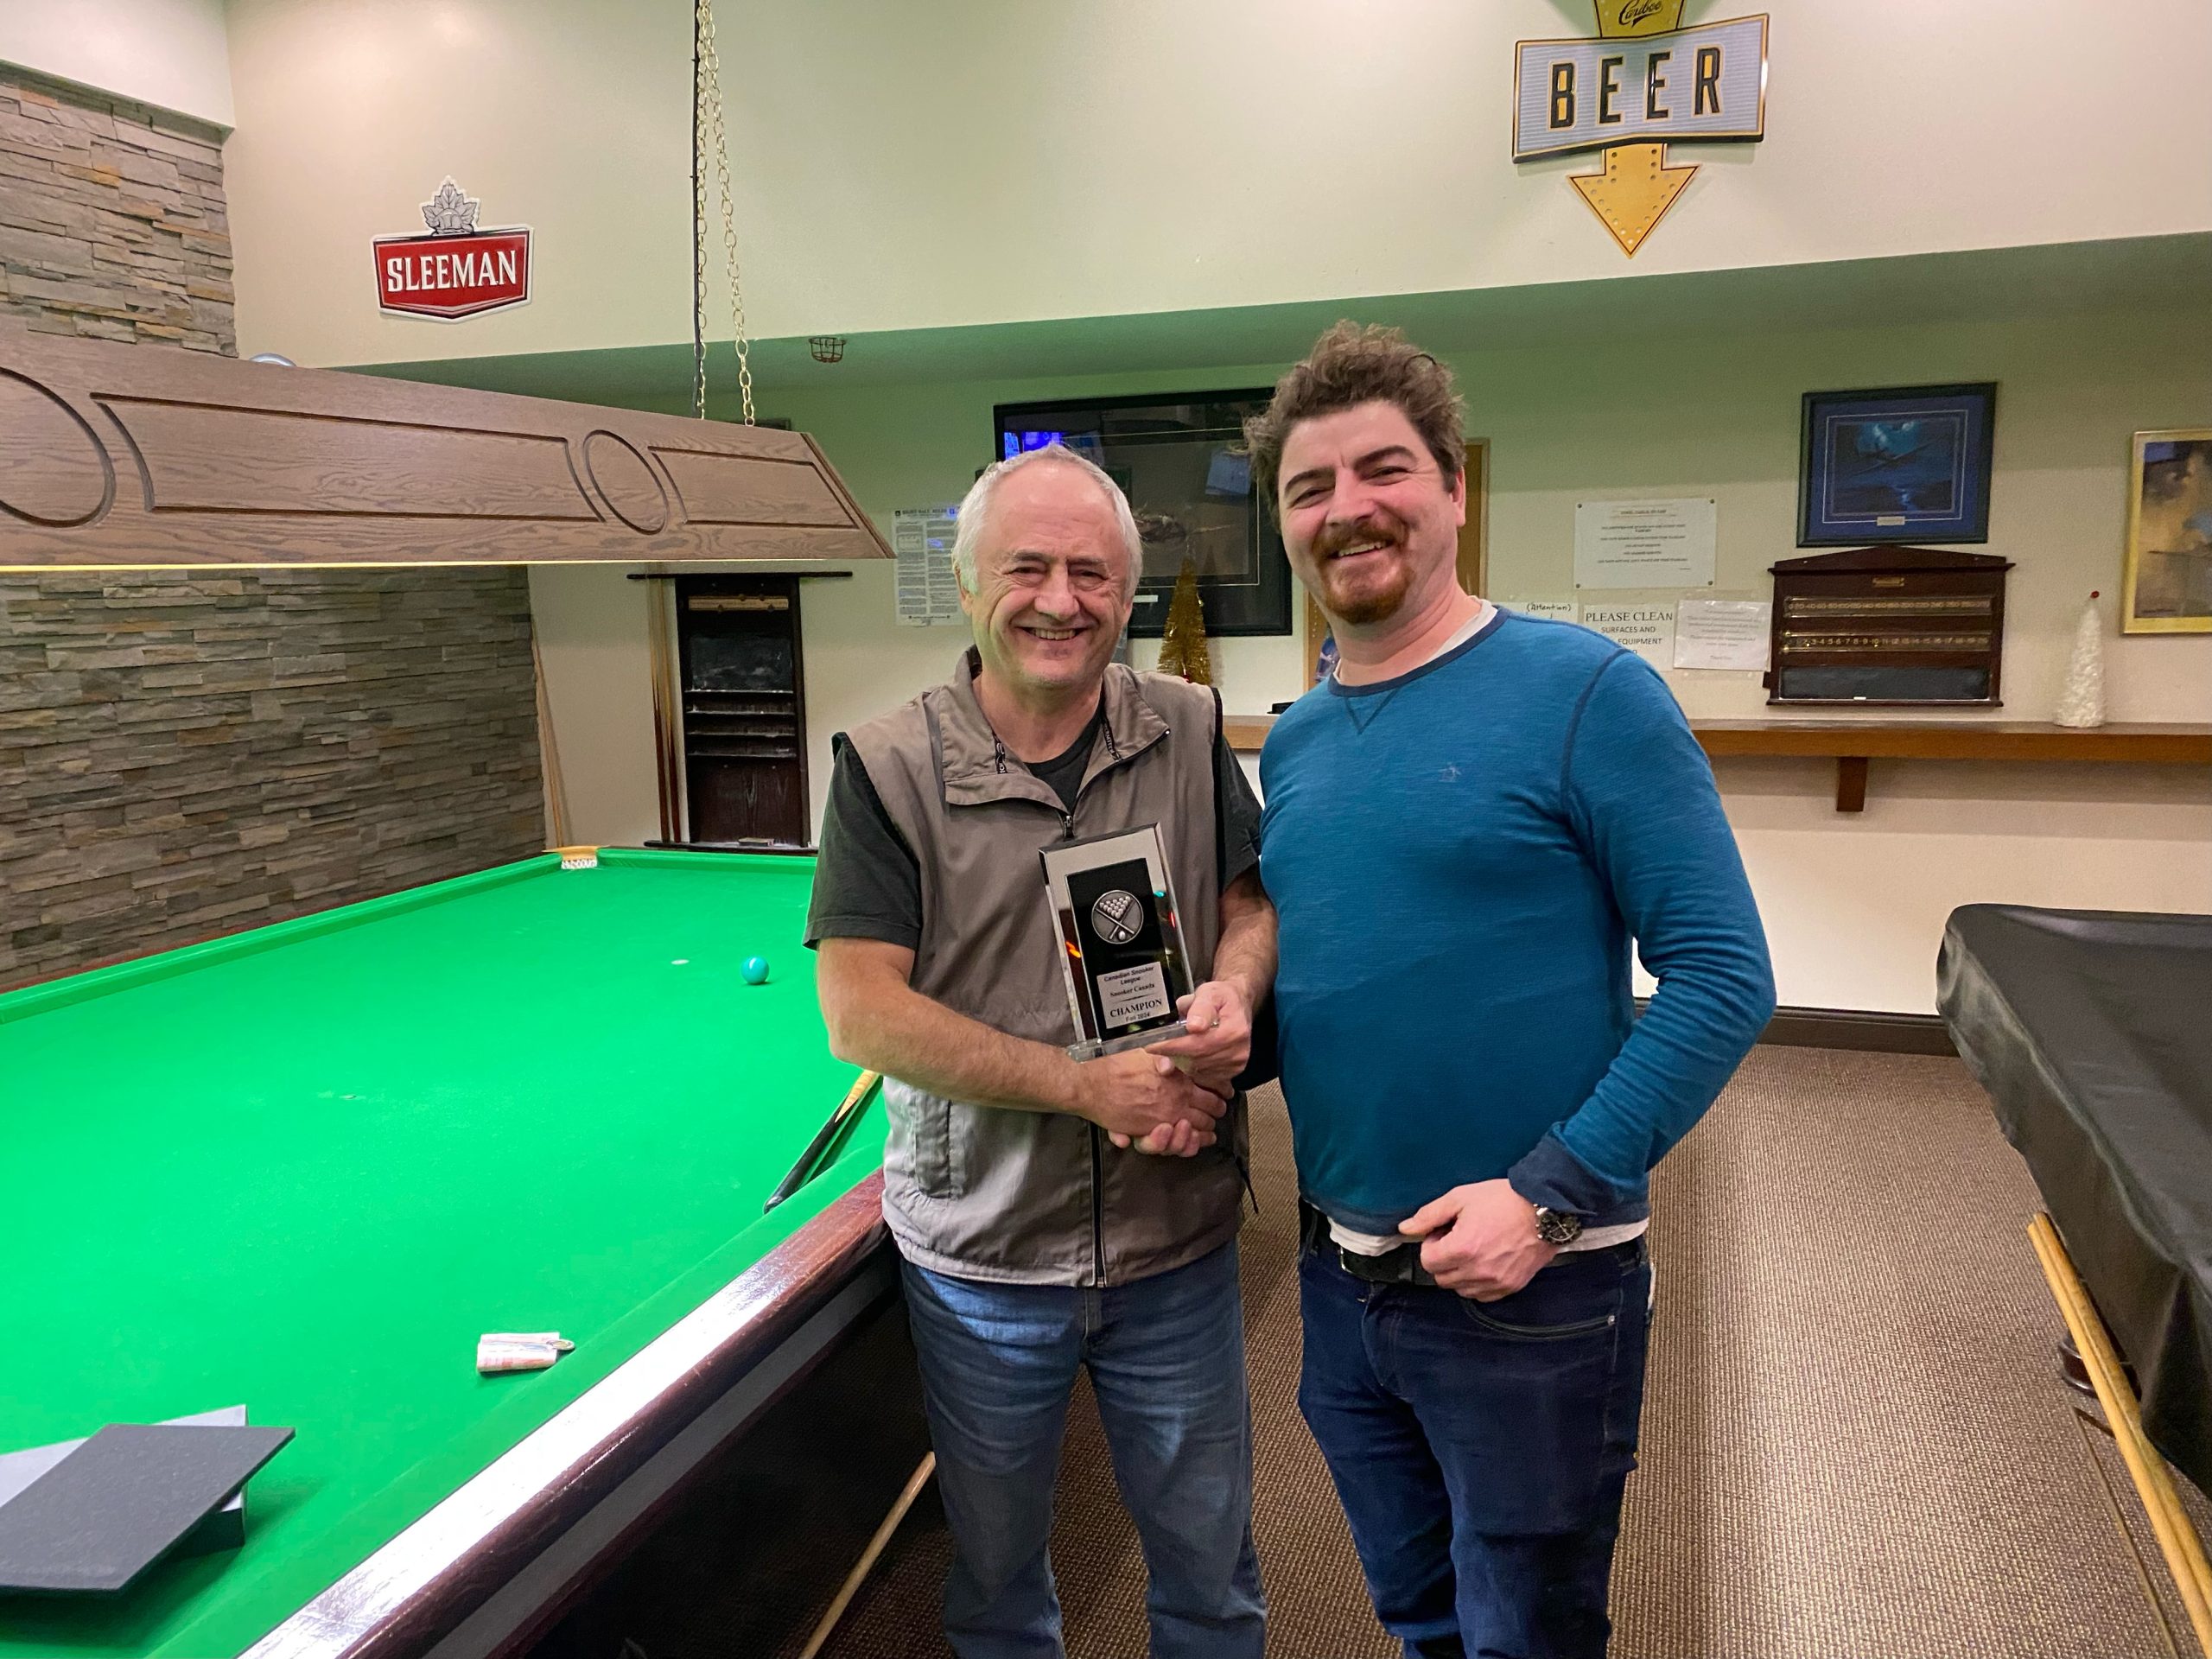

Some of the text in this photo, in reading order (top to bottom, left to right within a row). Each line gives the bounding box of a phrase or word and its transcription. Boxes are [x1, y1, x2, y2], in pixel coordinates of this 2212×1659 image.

[1549, 47, 1721, 129] BEER
[386, 250, 517, 293] SLEEMAN
[1586, 612, 1673, 622] PLEASE CLEAN
[1104, 972, 1130, 982] Canadian
[1134, 983, 1154, 992] Canada
[1110, 999, 1162, 1017] CHAMPION
